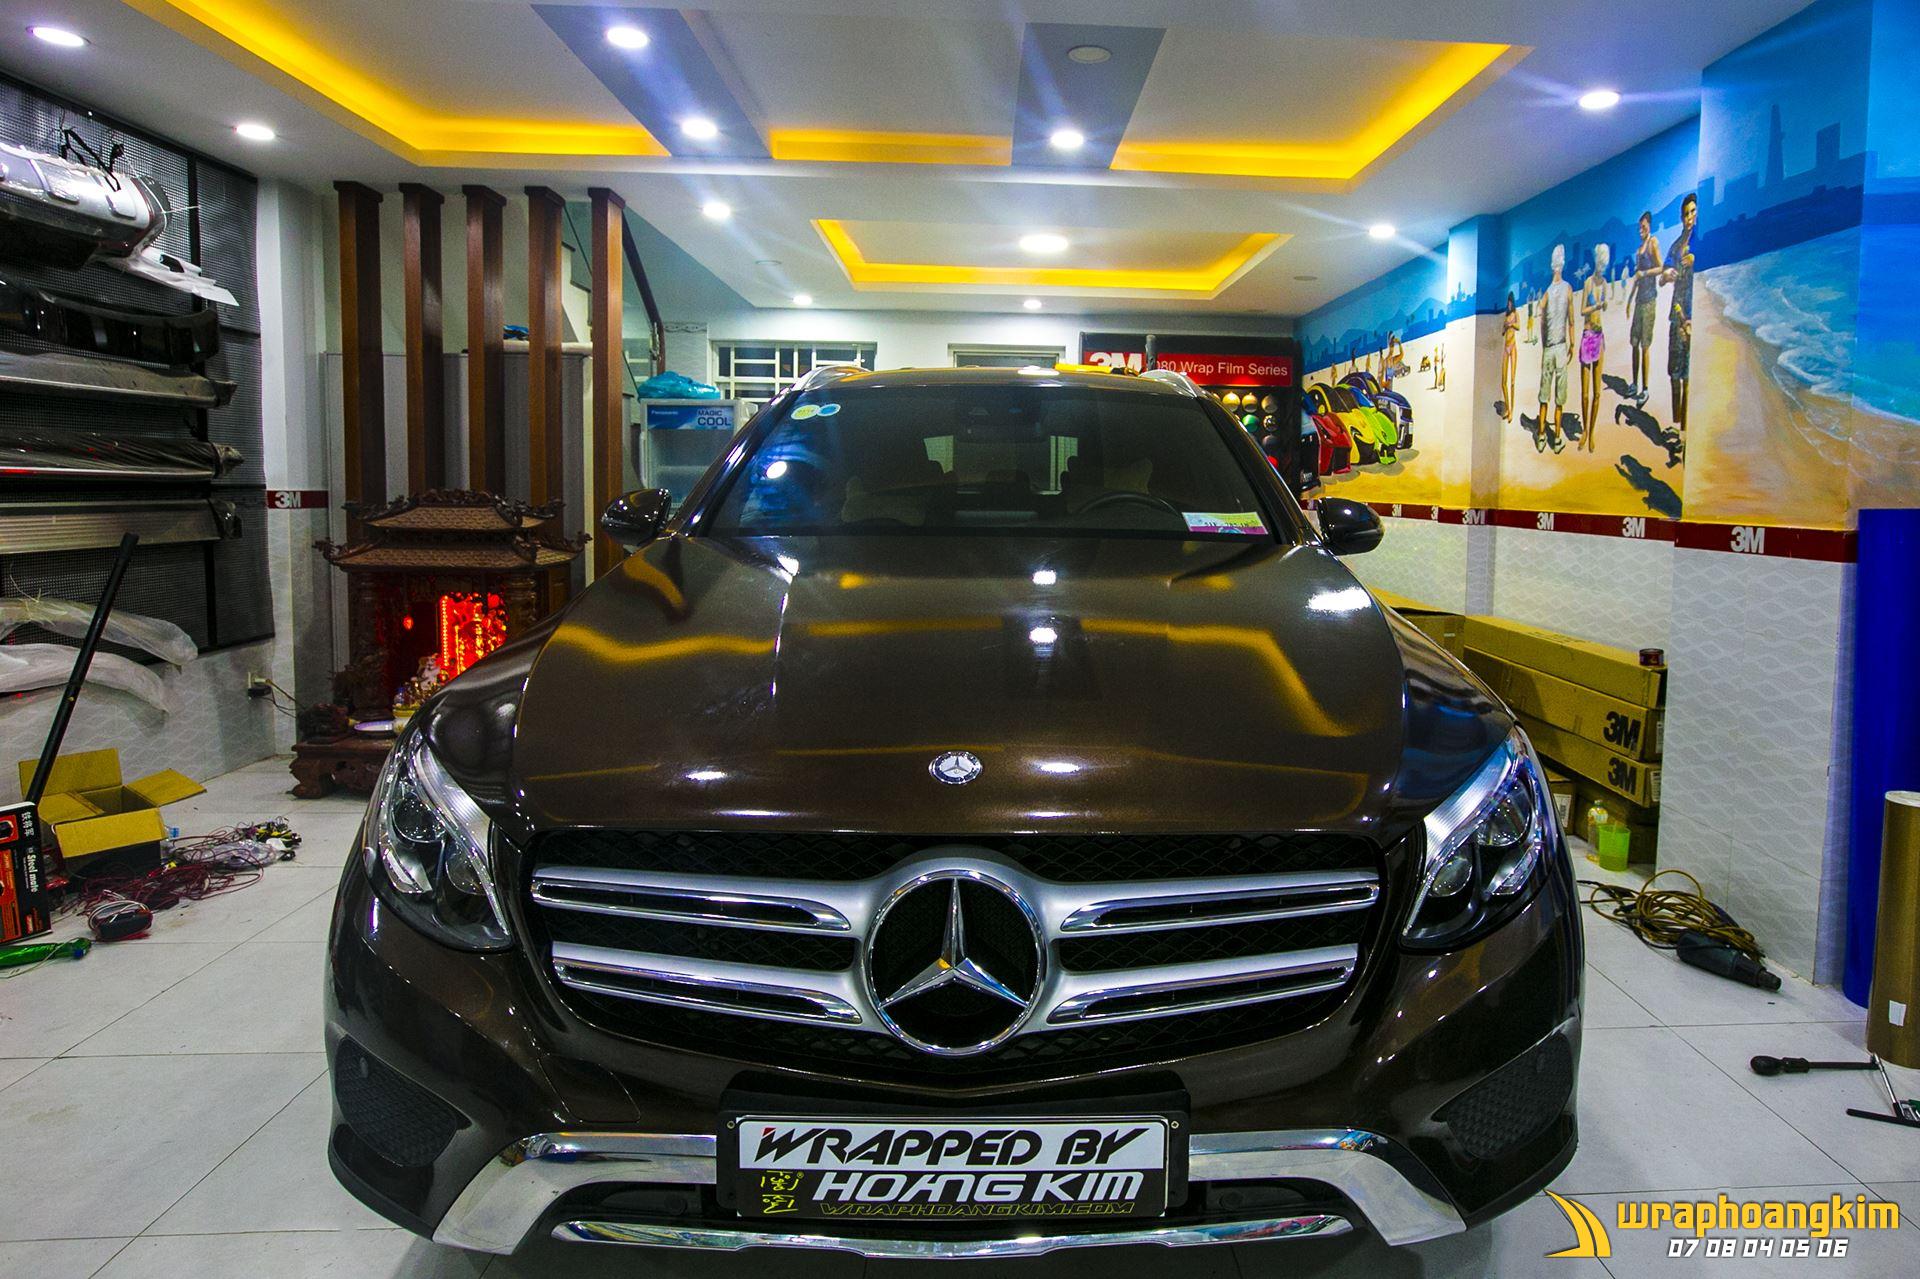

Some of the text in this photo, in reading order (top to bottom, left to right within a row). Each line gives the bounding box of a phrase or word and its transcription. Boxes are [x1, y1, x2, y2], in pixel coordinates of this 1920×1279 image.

[1180, 361, 1214, 376] Wrap
[1218, 362, 1244, 375] Film
[1247, 362, 1288, 377] Series
[698, 417, 731, 426] COOL
[275, 491, 301, 508] 3M
[1462, 509, 1485, 525] 3M
[1536, 512, 1554, 531] 3M
[1622, 517, 1645, 538] 3M
[1730, 526, 1765, 554] 3M
[1603, 711, 1641, 752] 3M
[1608, 757, 1637, 796] 3M
[27, 854, 39, 893] Steel mate
[754, 1127, 1150, 1166] WRAPPED BY
[812, 1171, 1027, 1203] HOANG
[1031, 1171, 1145, 1202] KIM
[820, 1201, 1135, 1216] WRAPHOANGKIM.COM
